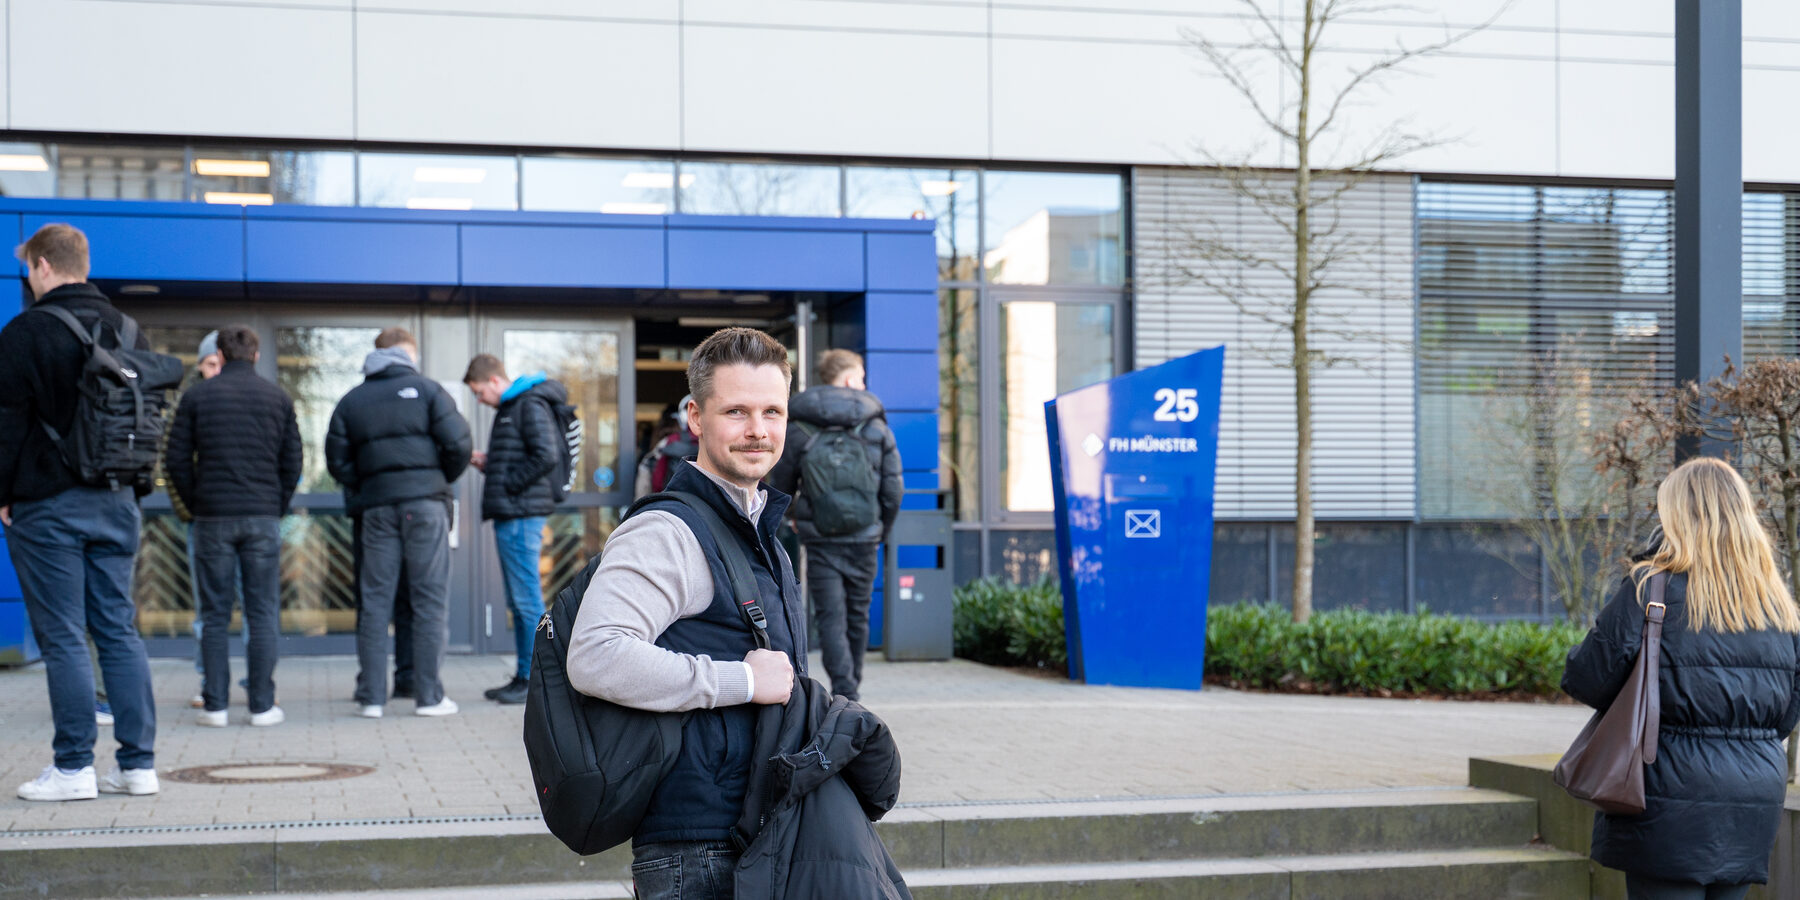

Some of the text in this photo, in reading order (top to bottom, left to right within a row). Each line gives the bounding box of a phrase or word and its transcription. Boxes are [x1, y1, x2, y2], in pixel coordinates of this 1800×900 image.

[1153, 388, 1199, 422] 25
[1109, 434, 1198, 452] FH MÜNSTER
